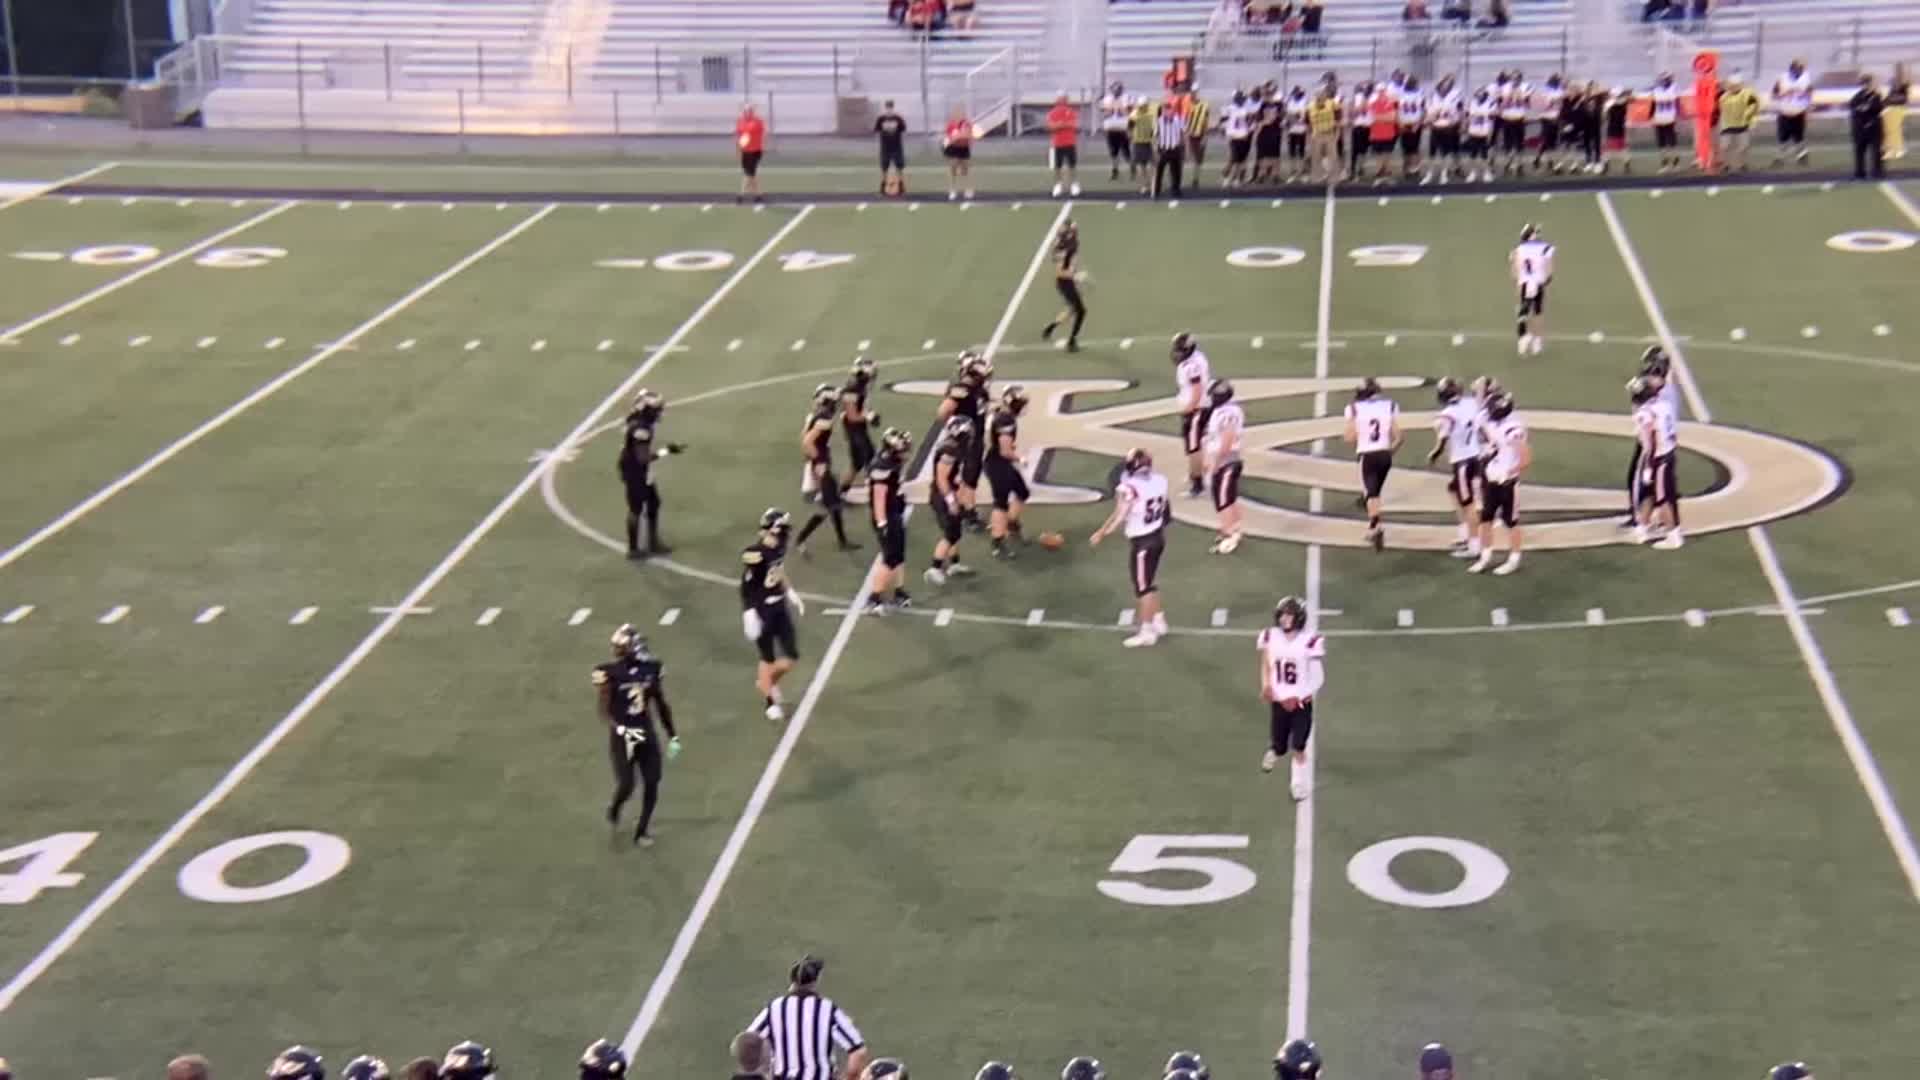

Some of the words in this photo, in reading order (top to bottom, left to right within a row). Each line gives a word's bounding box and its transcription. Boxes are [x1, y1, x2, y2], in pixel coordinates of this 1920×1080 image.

[1368, 418, 1381, 443] 3
[1275, 659, 1298, 685] 16
[626, 686, 646, 715] 3
